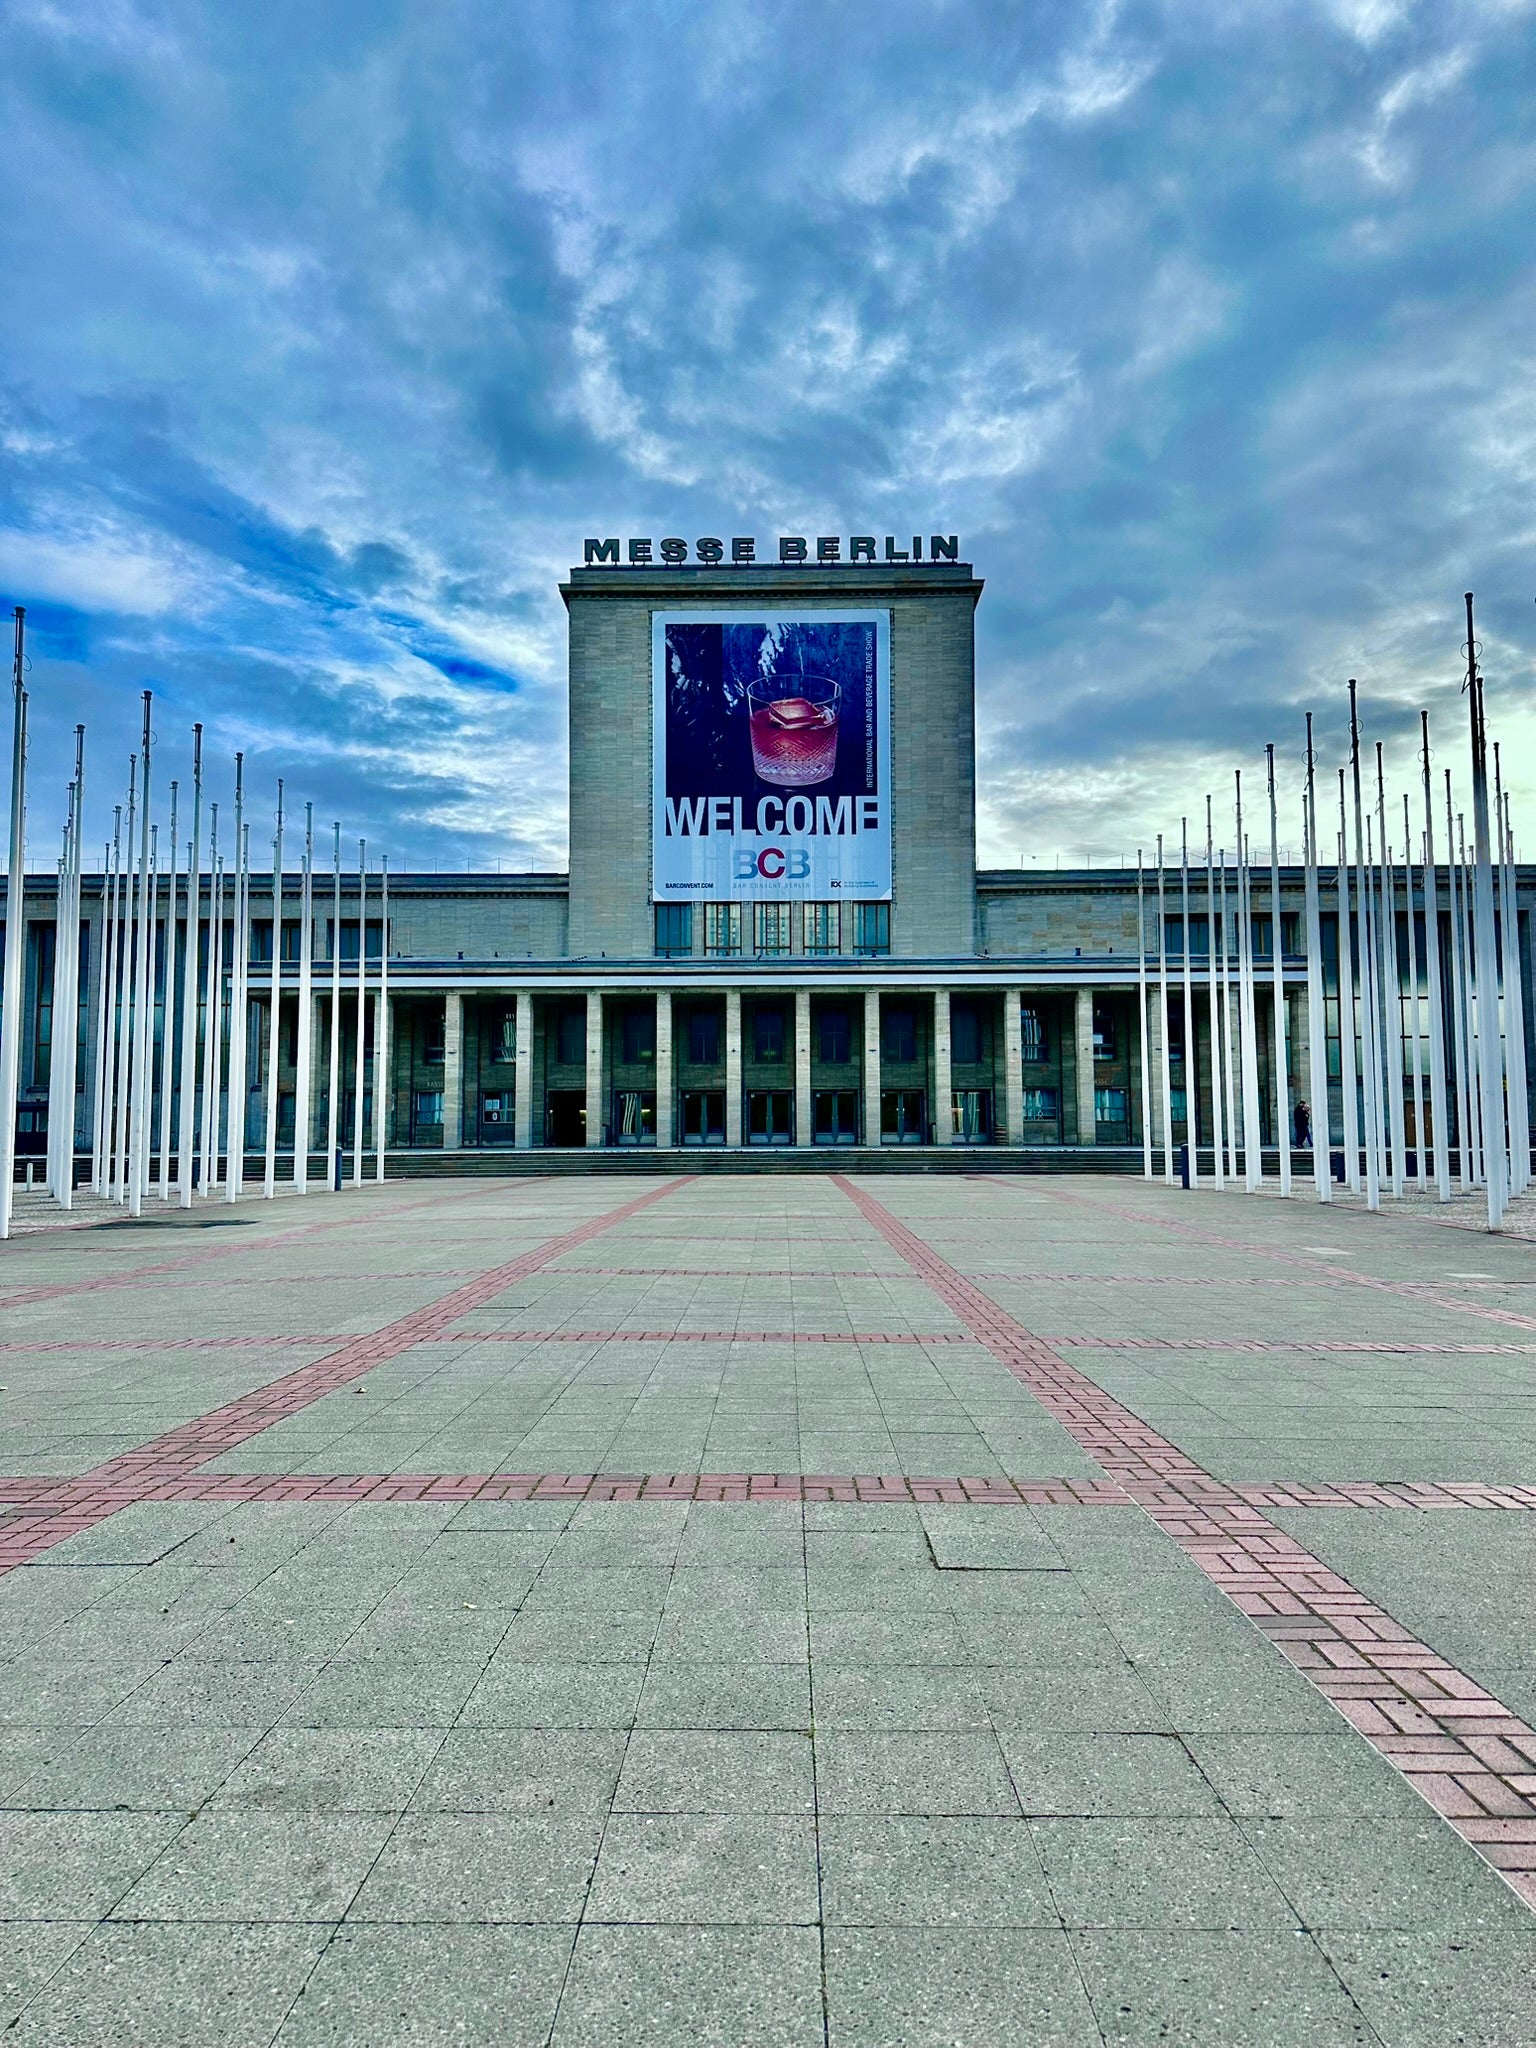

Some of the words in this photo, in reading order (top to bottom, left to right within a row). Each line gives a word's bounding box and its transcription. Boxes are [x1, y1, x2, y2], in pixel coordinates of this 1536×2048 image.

[584, 537, 755, 563] MESSE
[779, 535, 958, 561] BERLIN
[666, 796, 878, 836] WELCOME
[733, 848, 811, 879] BCB
